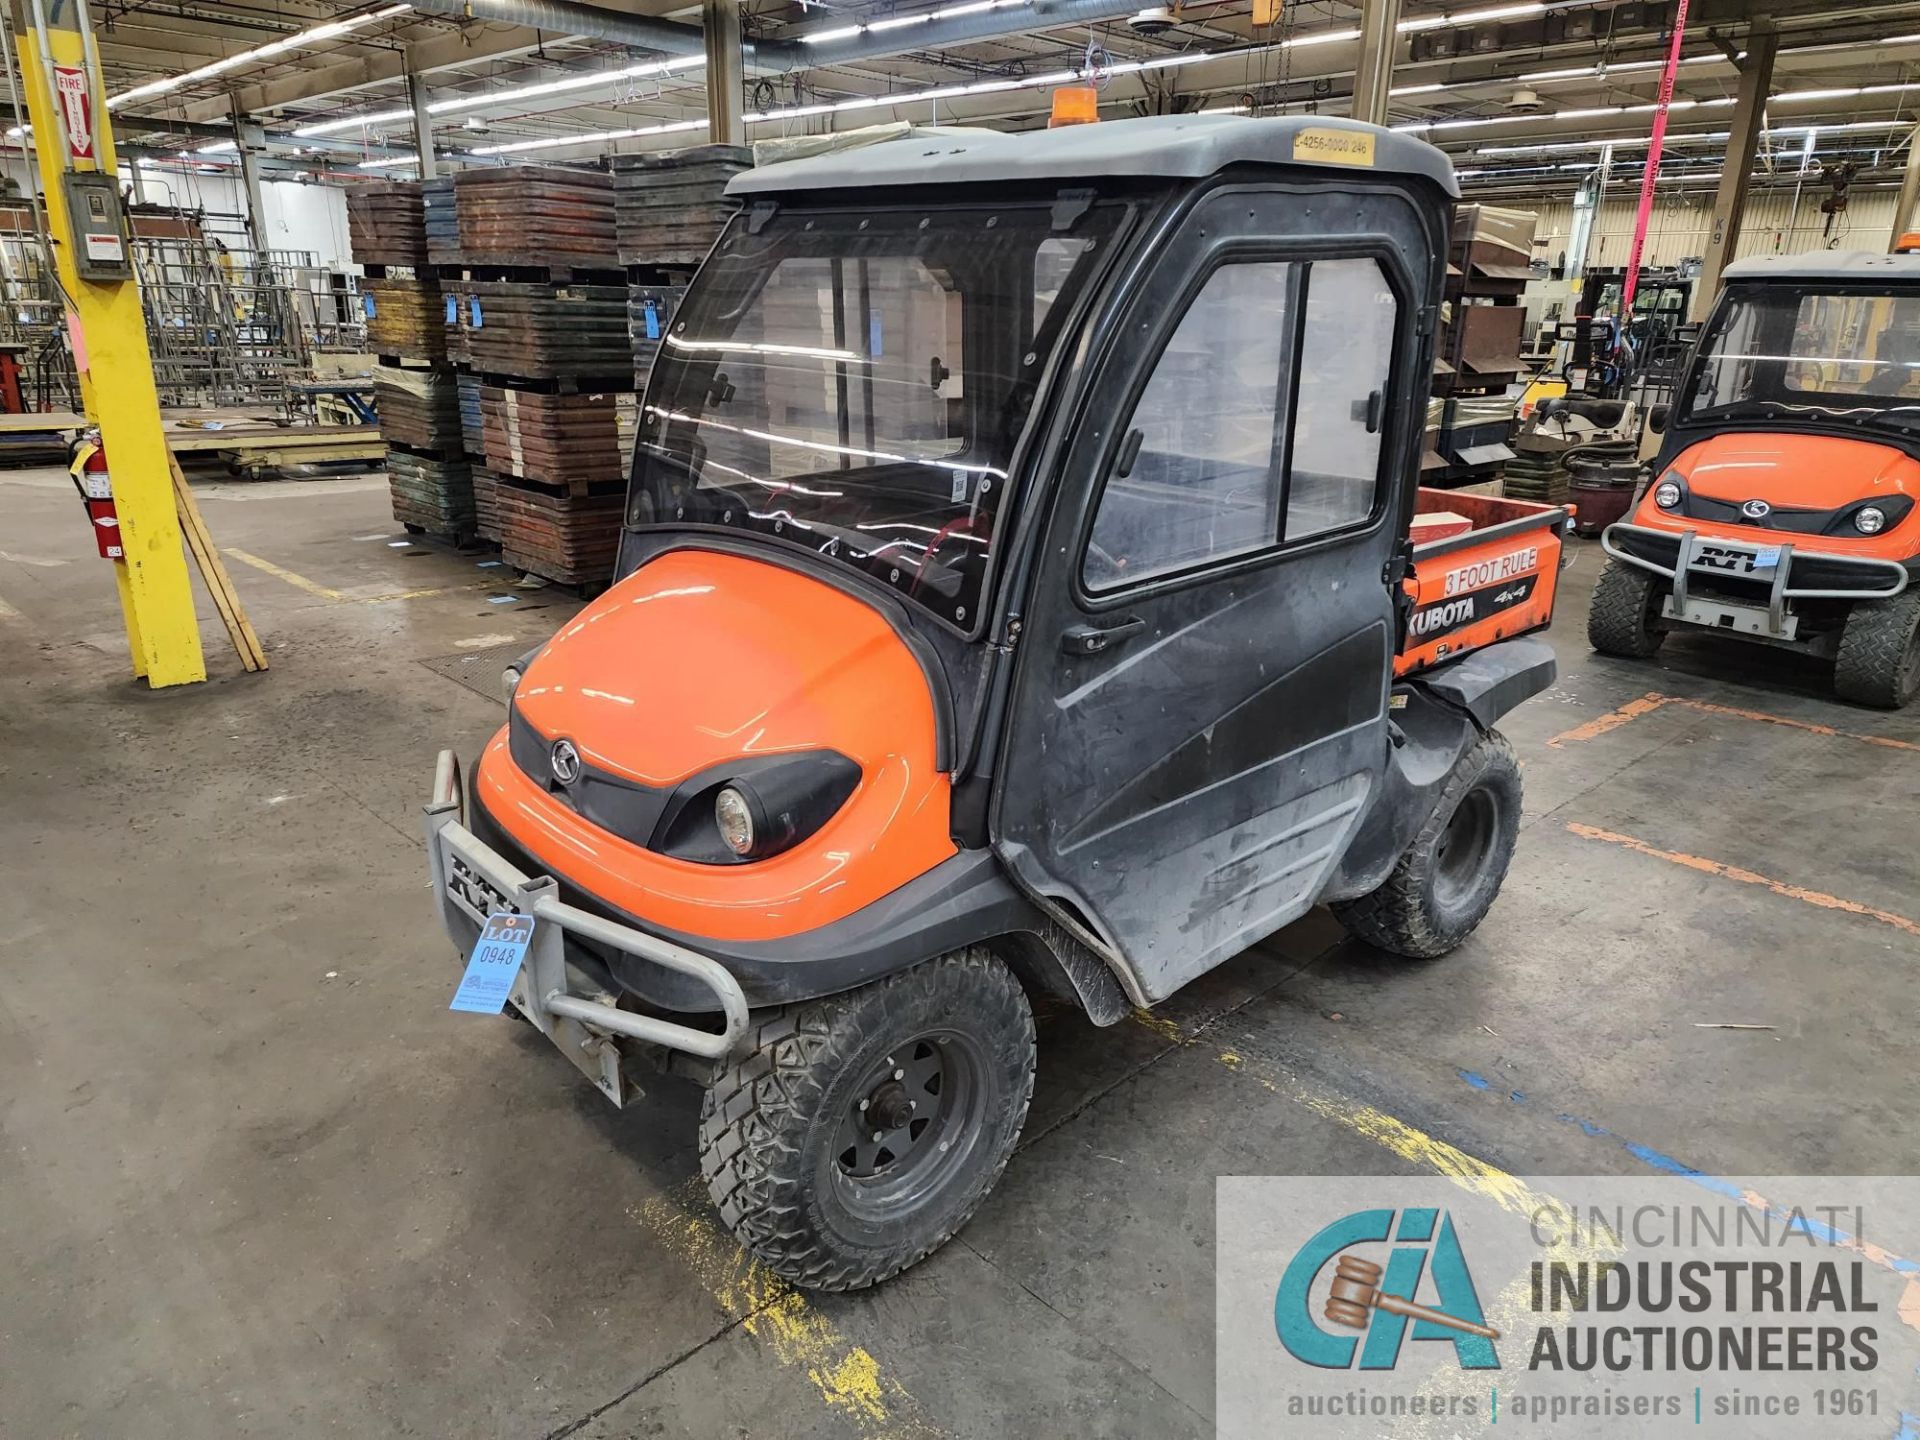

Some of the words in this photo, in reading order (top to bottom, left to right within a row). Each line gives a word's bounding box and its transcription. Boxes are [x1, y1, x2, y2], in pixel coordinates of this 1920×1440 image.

[59, 77, 81, 90] FIRE
[1646, 160, 1658, 197] DANGER
[109, 547, 120, 555] 24
[1445, 574, 1454, 595] 3
[1457, 562, 1498, 592] FOOT
[1500, 548, 1537, 579] RULE
[1409, 597, 1475, 637] KUBOTA
[1494, 585, 1526, 603] 4x4
[486, 926, 527, 944] LOT
[480, 946, 516, 966] 0948
